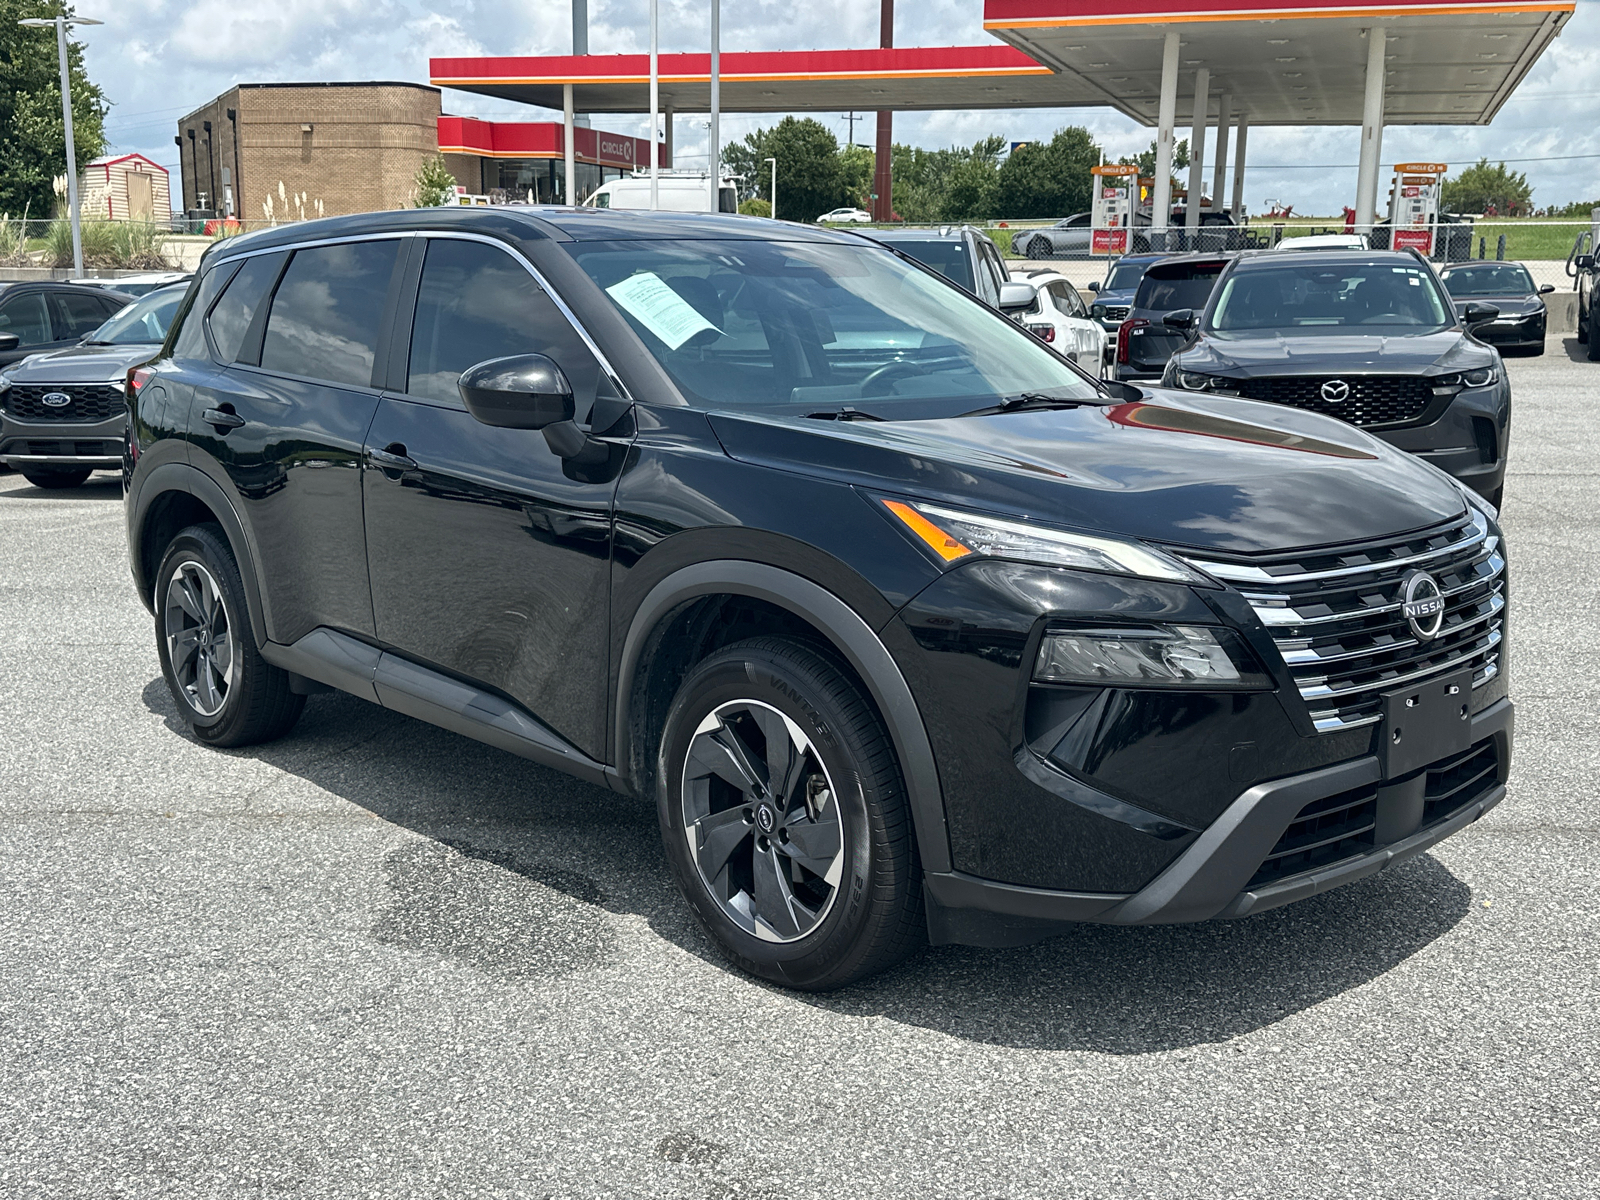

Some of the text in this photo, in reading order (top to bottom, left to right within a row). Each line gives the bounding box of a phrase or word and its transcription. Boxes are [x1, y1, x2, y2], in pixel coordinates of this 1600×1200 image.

[602, 141, 632, 160] CIRCLE K
[1427, 164, 1436, 172] K
